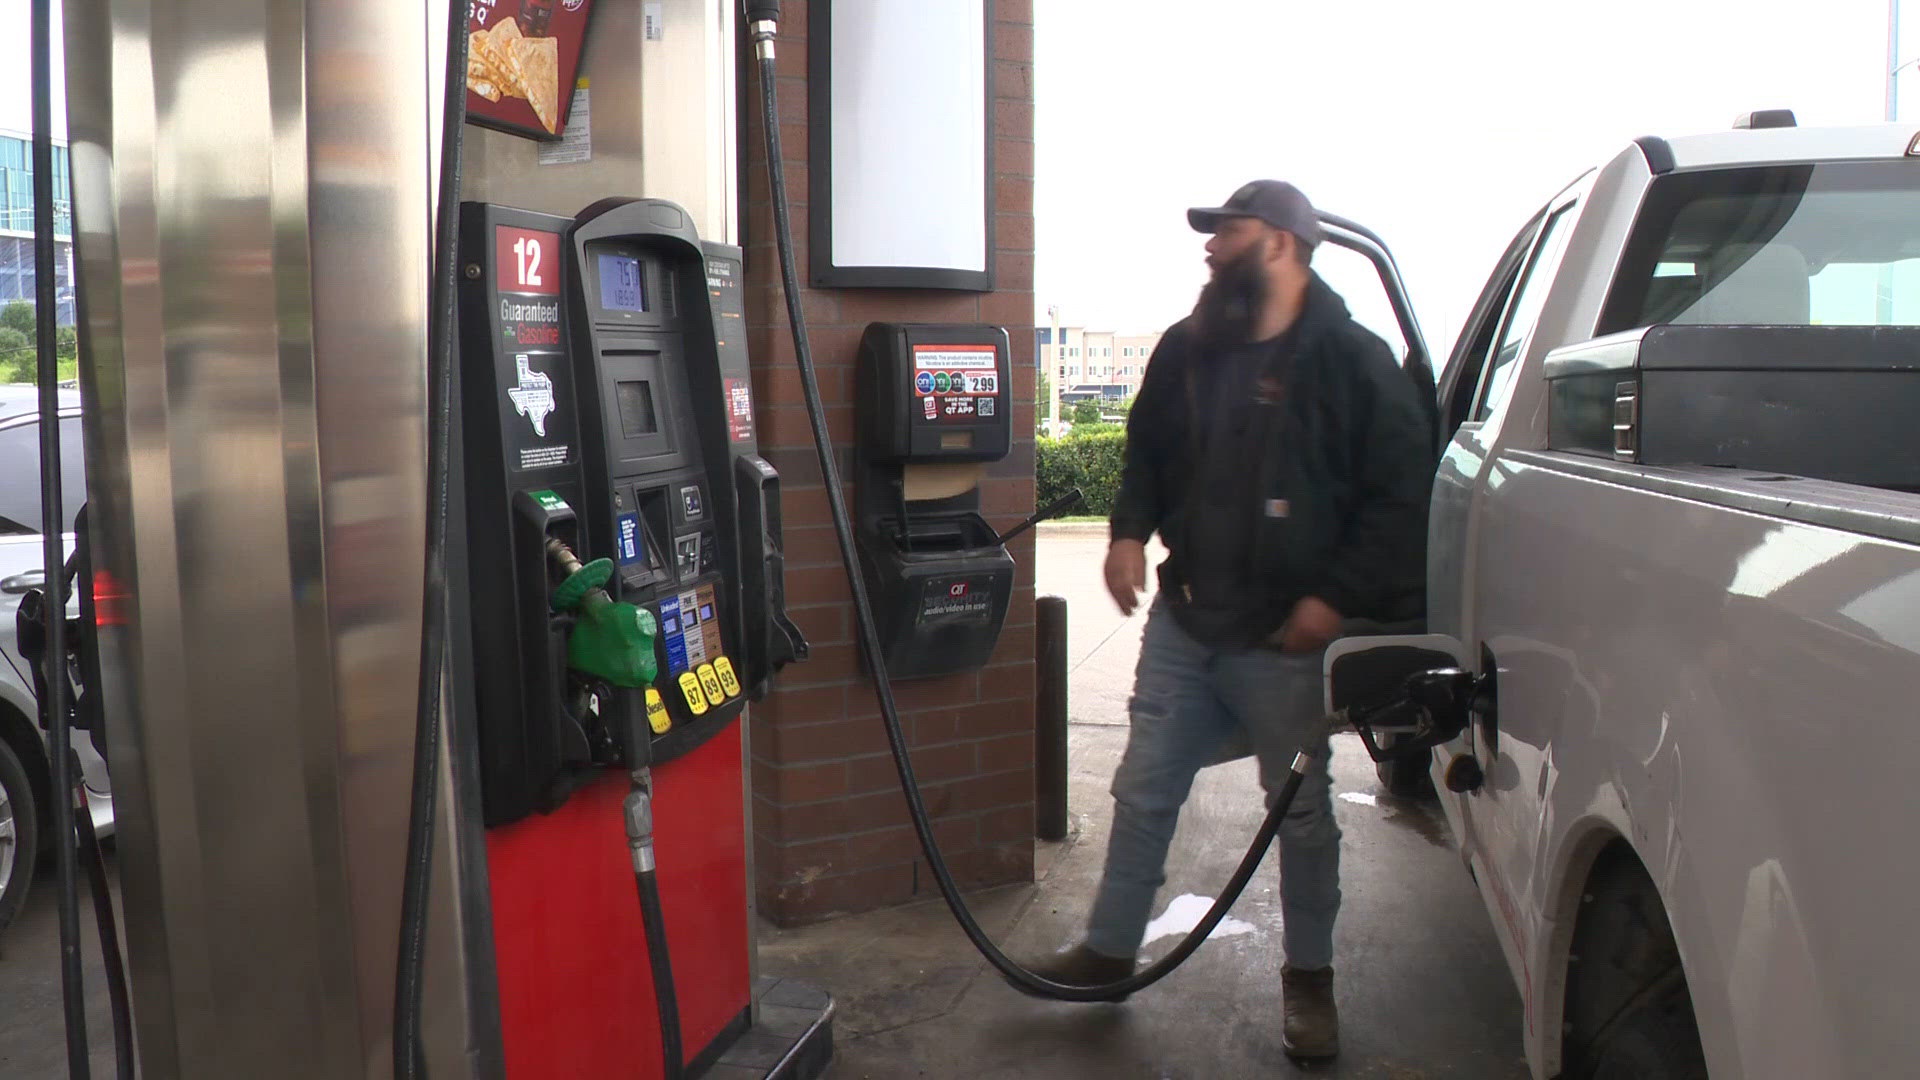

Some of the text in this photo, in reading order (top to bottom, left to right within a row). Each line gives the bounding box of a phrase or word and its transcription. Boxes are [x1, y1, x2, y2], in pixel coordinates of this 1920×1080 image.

[513, 237, 542, 287] 12
[501, 299, 559, 323] Guaranteed
[517, 322, 559, 345] Gasoline
[945, 406, 974, 415] QT APP
[951, 584, 965, 595] QT
[924, 603, 965, 615] audio/video
[705, 677, 719, 696] 89
[721, 670, 734, 688] 93
[687, 686, 701, 705] 87
